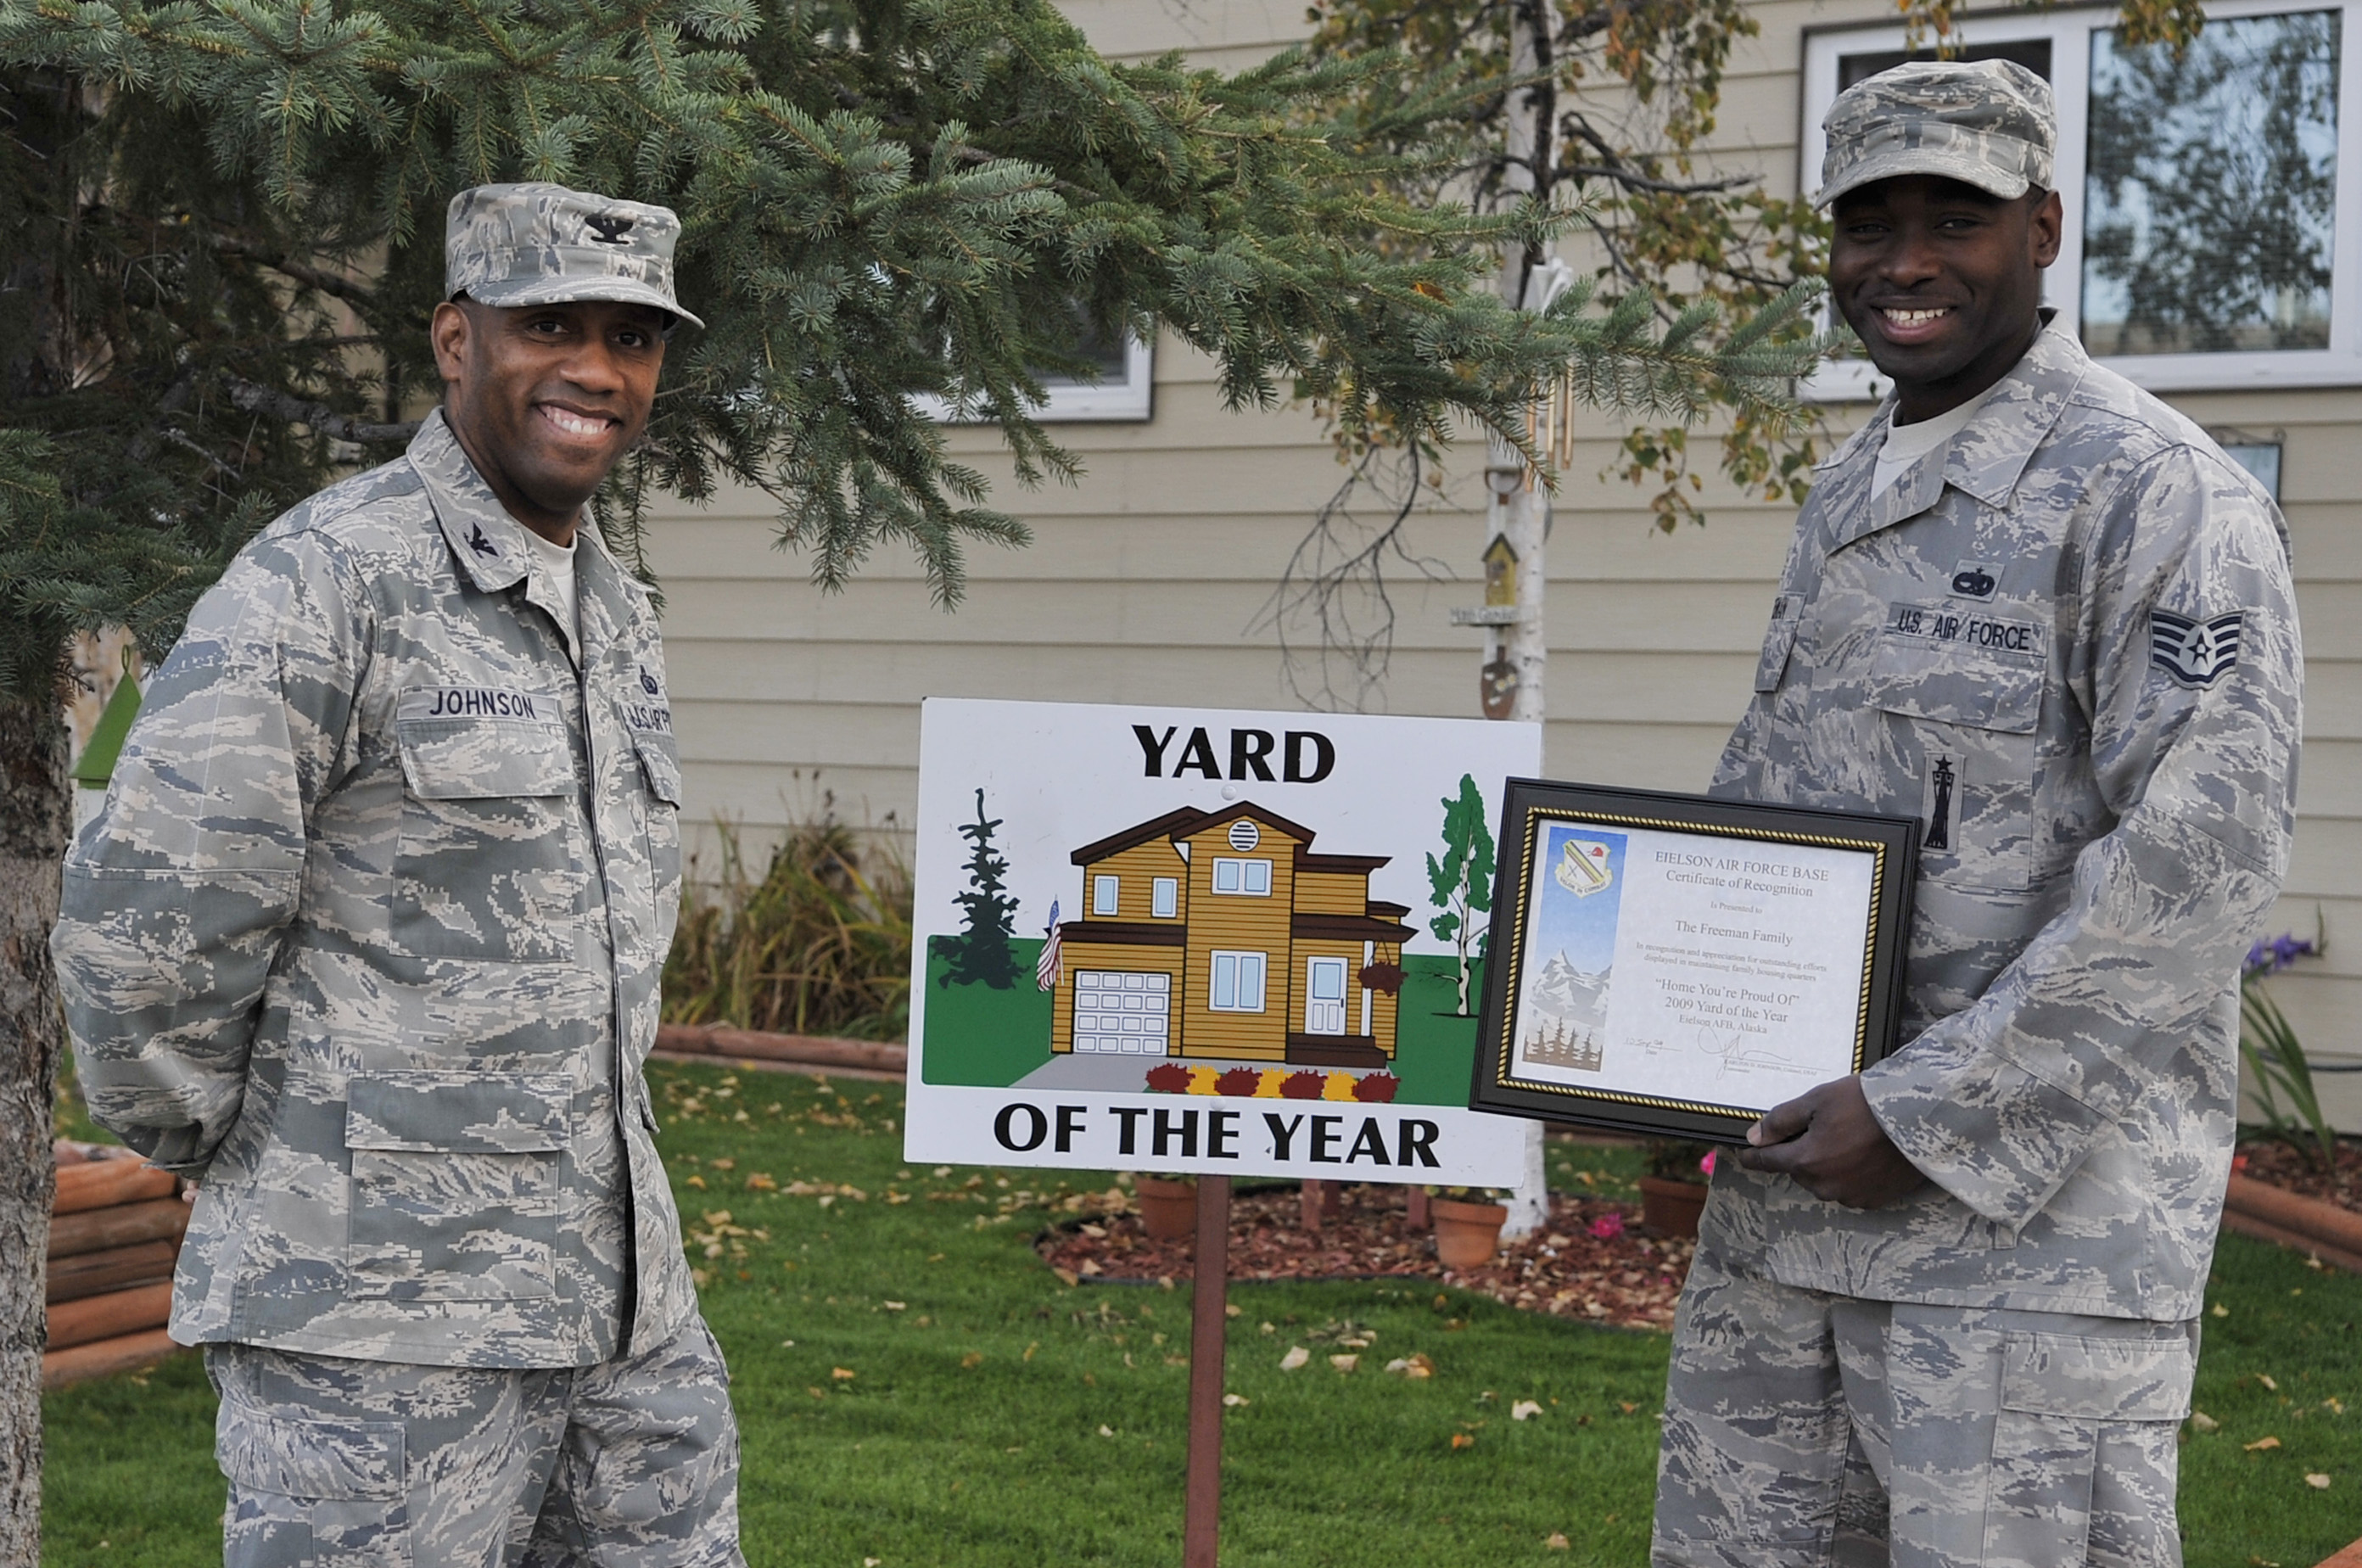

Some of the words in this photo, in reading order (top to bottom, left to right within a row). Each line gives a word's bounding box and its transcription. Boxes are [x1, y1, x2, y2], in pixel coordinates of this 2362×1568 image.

[1899, 609, 1922, 634] U.S.
[1932, 615, 1959, 640] AIR
[1967, 620, 2031, 650] FORCE
[429, 691, 537, 720] JOHNSON
[1132, 725, 1336, 783] YARD
[1654, 851, 1713, 869] EIELSON
[1716, 859, 1739, 871] AIR
[1744, 861, 1788, 877] FORCE
[1793, 865, 1829, 882] BASE
[1665, 869, 1725, 888] Certificate
[1728, 877, 1743, 889] of
[1744, 880, 1813, 898] Recognition
[1719, 902, 1754, 915] Presented
[1676, 920, 1697, 933] The
[1700, 923, 1749, 940] Freeman
[1753, 929, 1794, 947] Family
[1643, 954, 1677, 966] displayed
[1687, 949, 1700, 957] and
[1702, 950, 1745, 962] appreciation
[1747, 955, 1759, 964] for
[1803, 962, 1827, 972] efforts
[1665, 996, 1694, 1011] 2009
[1697, 1000, 1723, 1015] Yard
[1726, 1005, 1740, 1016] of
[1742, 1006, 1759, 1019] the
[1762, 1009, 1788, 1023] Year
[1740, 988, 1774, 1004] Proud
[1679, 1014, 1711, 1028] Eielson
[1712, 1020, 1736, 1031] AFB,
[1738, 1022, 1767, 1034] Alaska
[993, 1103, 1088, 1152] OF
[1109, 1106, 1240, 1160] THE
[1263, 1112, 1441, 1168] YEAR
